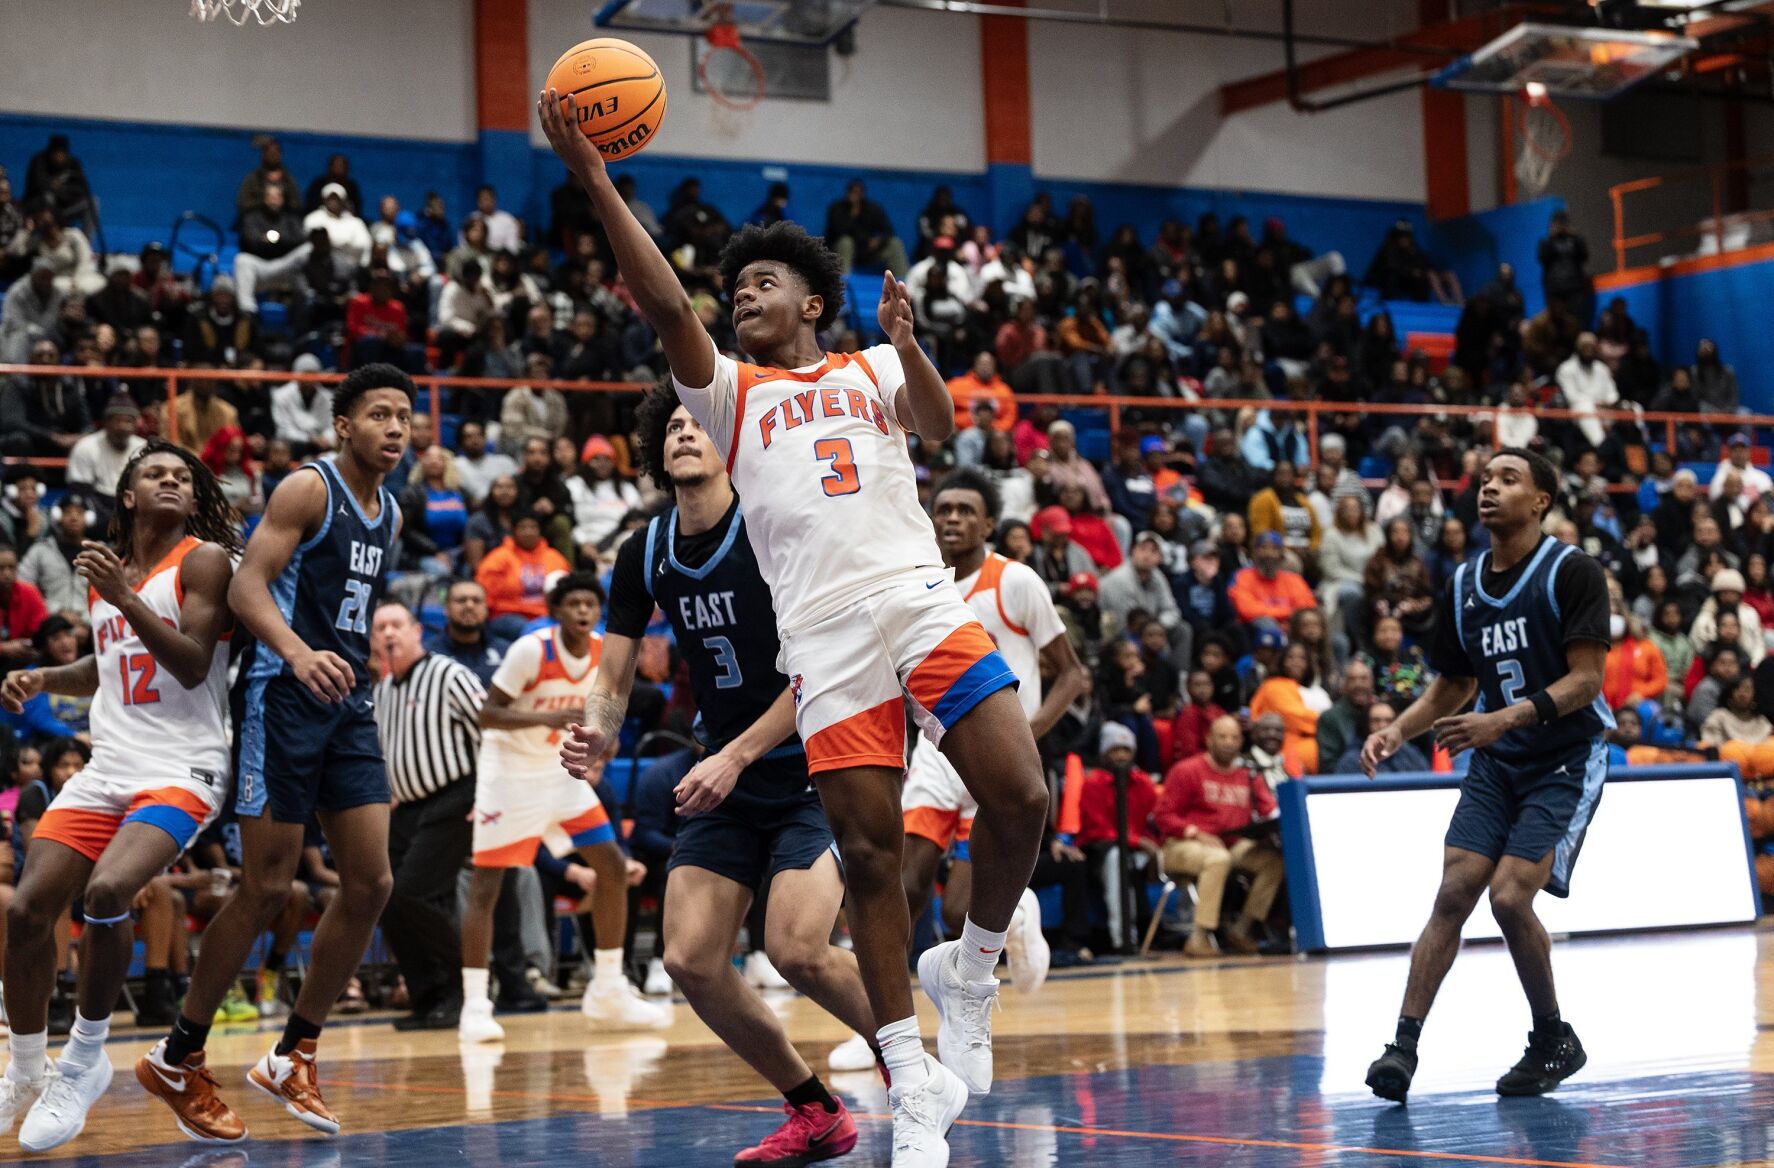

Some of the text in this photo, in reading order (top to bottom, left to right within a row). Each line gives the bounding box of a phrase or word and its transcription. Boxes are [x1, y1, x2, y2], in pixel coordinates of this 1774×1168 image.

[598, 123, 652, 155] Wils
[813, 437, 861, 497] 3
[350, 540, 384, 578] EAST
[679, 591, 737, 630] EAST
[1481, 616, 1528, 657] EAST
[119, 653, 160, 706] 12
[702, 635, 743, 689] 3
[1496, 658, 1528, 707] 2
